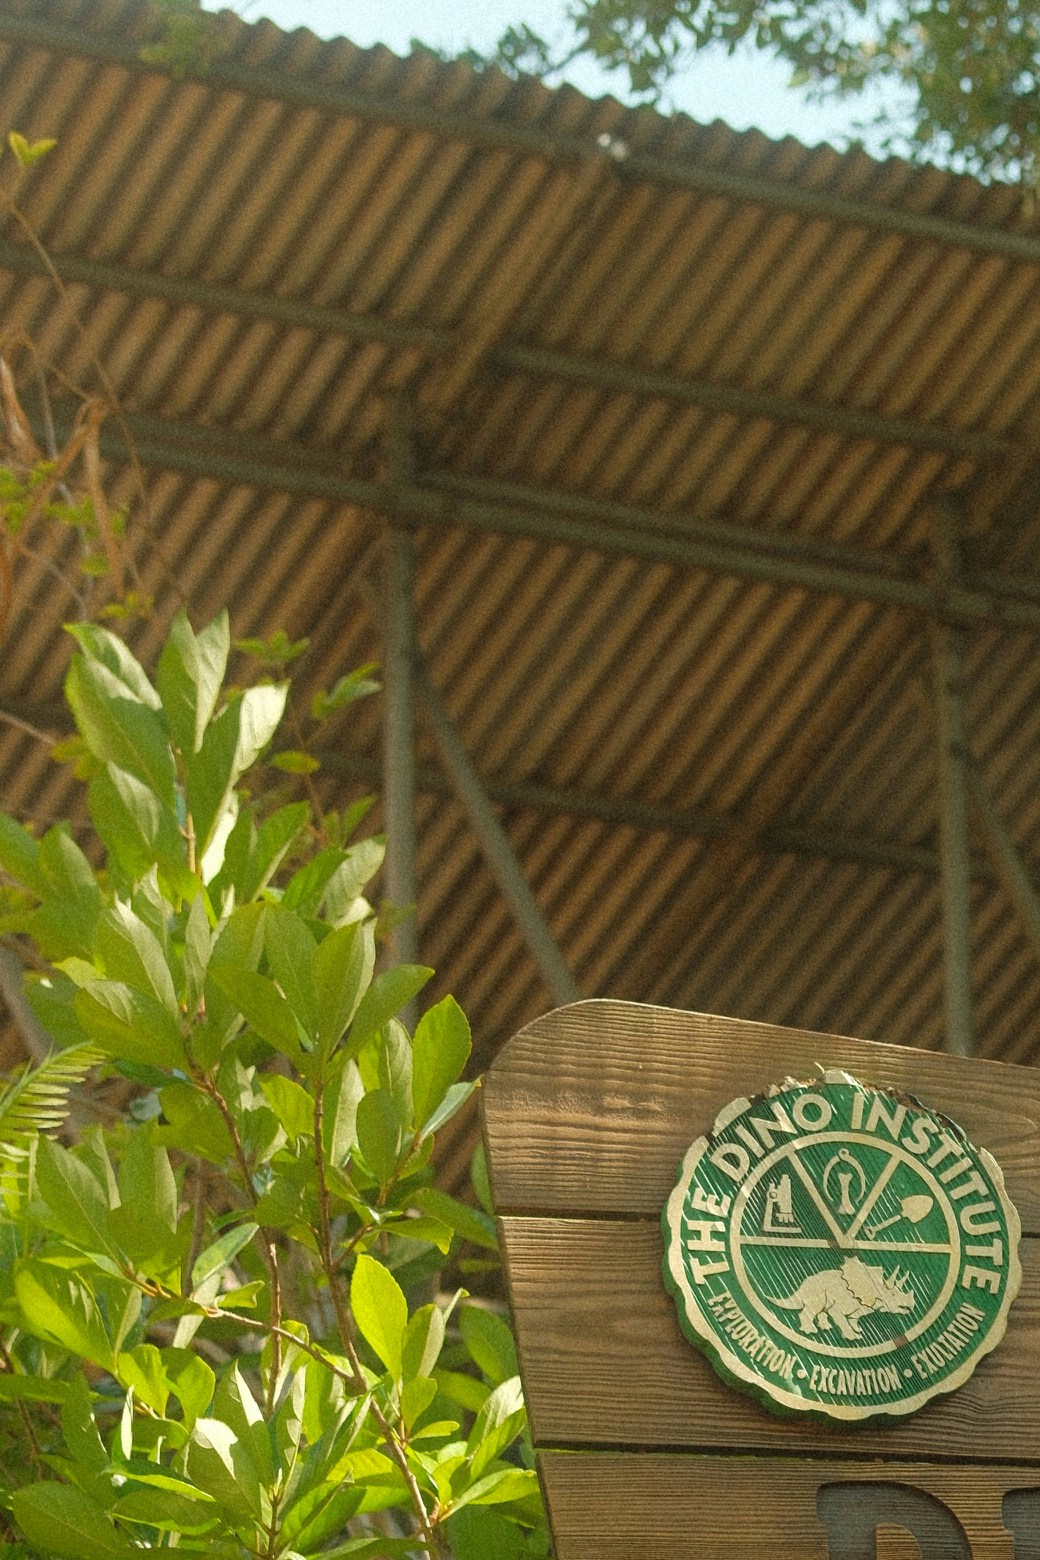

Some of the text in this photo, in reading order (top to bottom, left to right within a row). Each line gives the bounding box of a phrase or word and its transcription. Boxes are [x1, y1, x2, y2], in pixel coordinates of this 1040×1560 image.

[687, 1092, 1004, 1295] THE DINO INSTITUTE
[707, 1290, 986, 1396] EXPLORATION EXCAVATION EXULTATION
